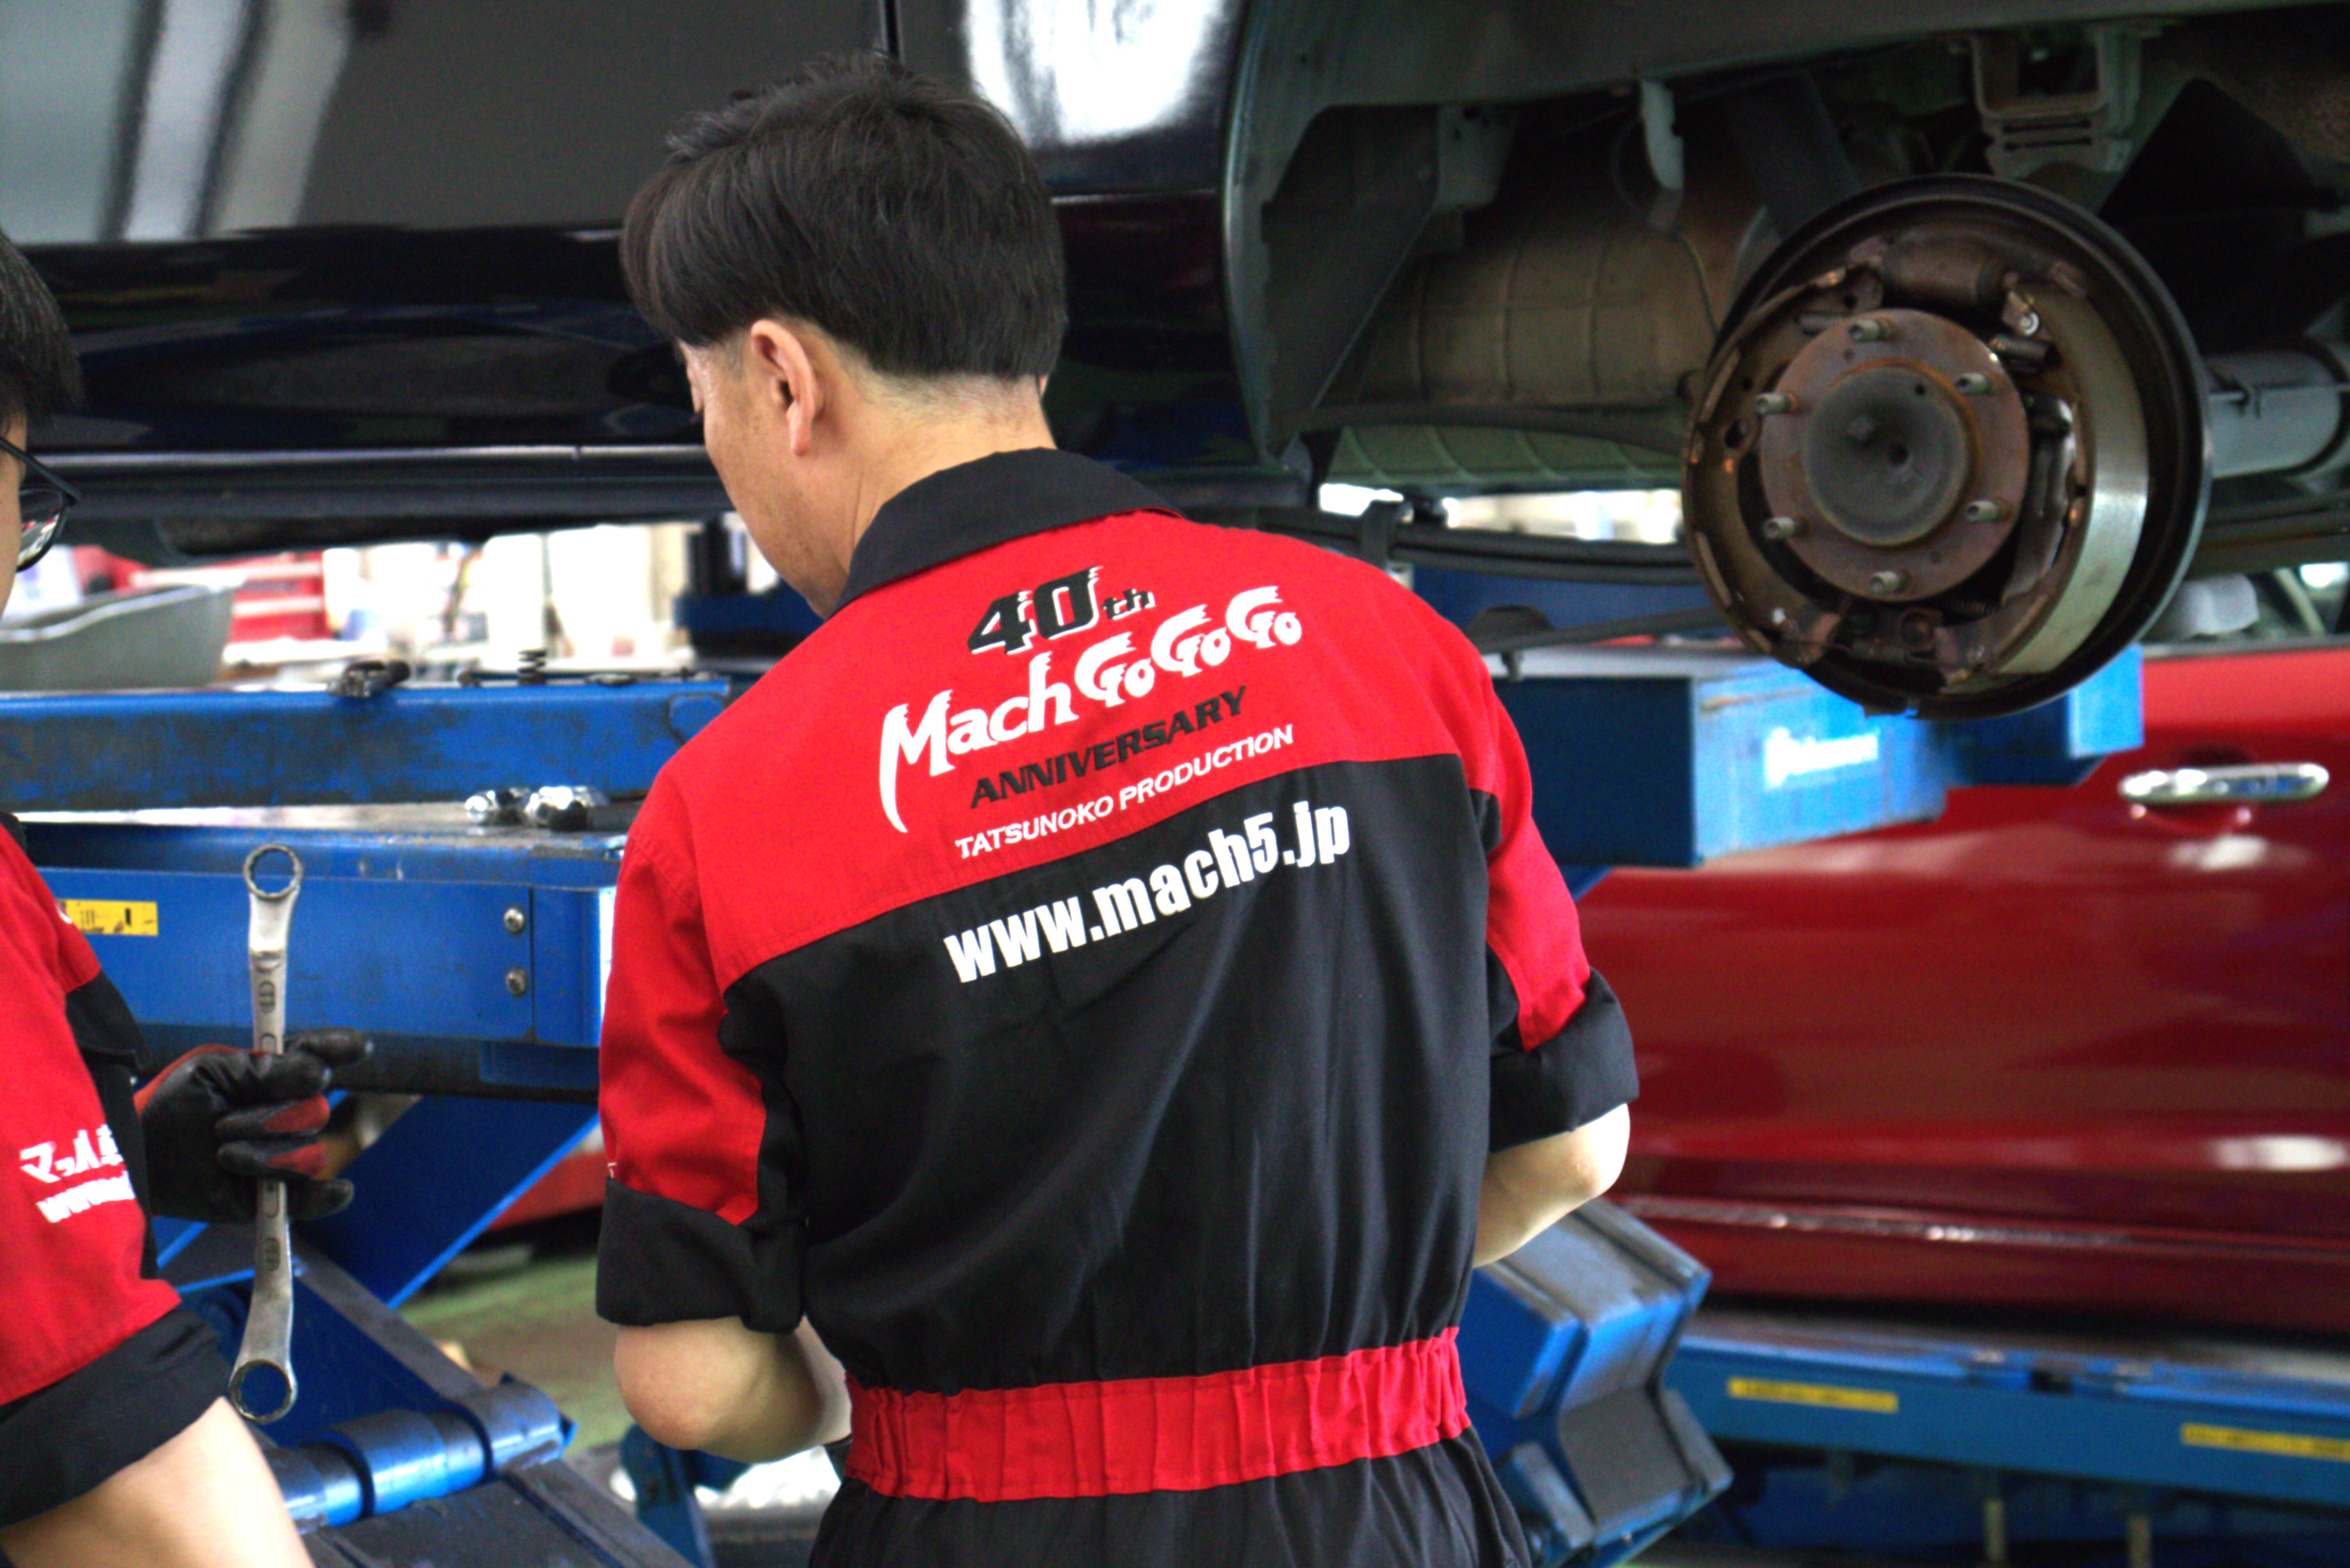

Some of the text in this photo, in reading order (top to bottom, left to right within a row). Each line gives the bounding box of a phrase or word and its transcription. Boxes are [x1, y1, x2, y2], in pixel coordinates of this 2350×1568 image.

[967, 566, 1156, 655] 40th
[879, 650, 1079, 833] Mach
[954, 724, 1294, 859] TATSUNOKO PRODUCTION
[970, 685, 1247, 809] ANNIVERSARY
[943, 800, 1350, 983] www.mach5.jp
